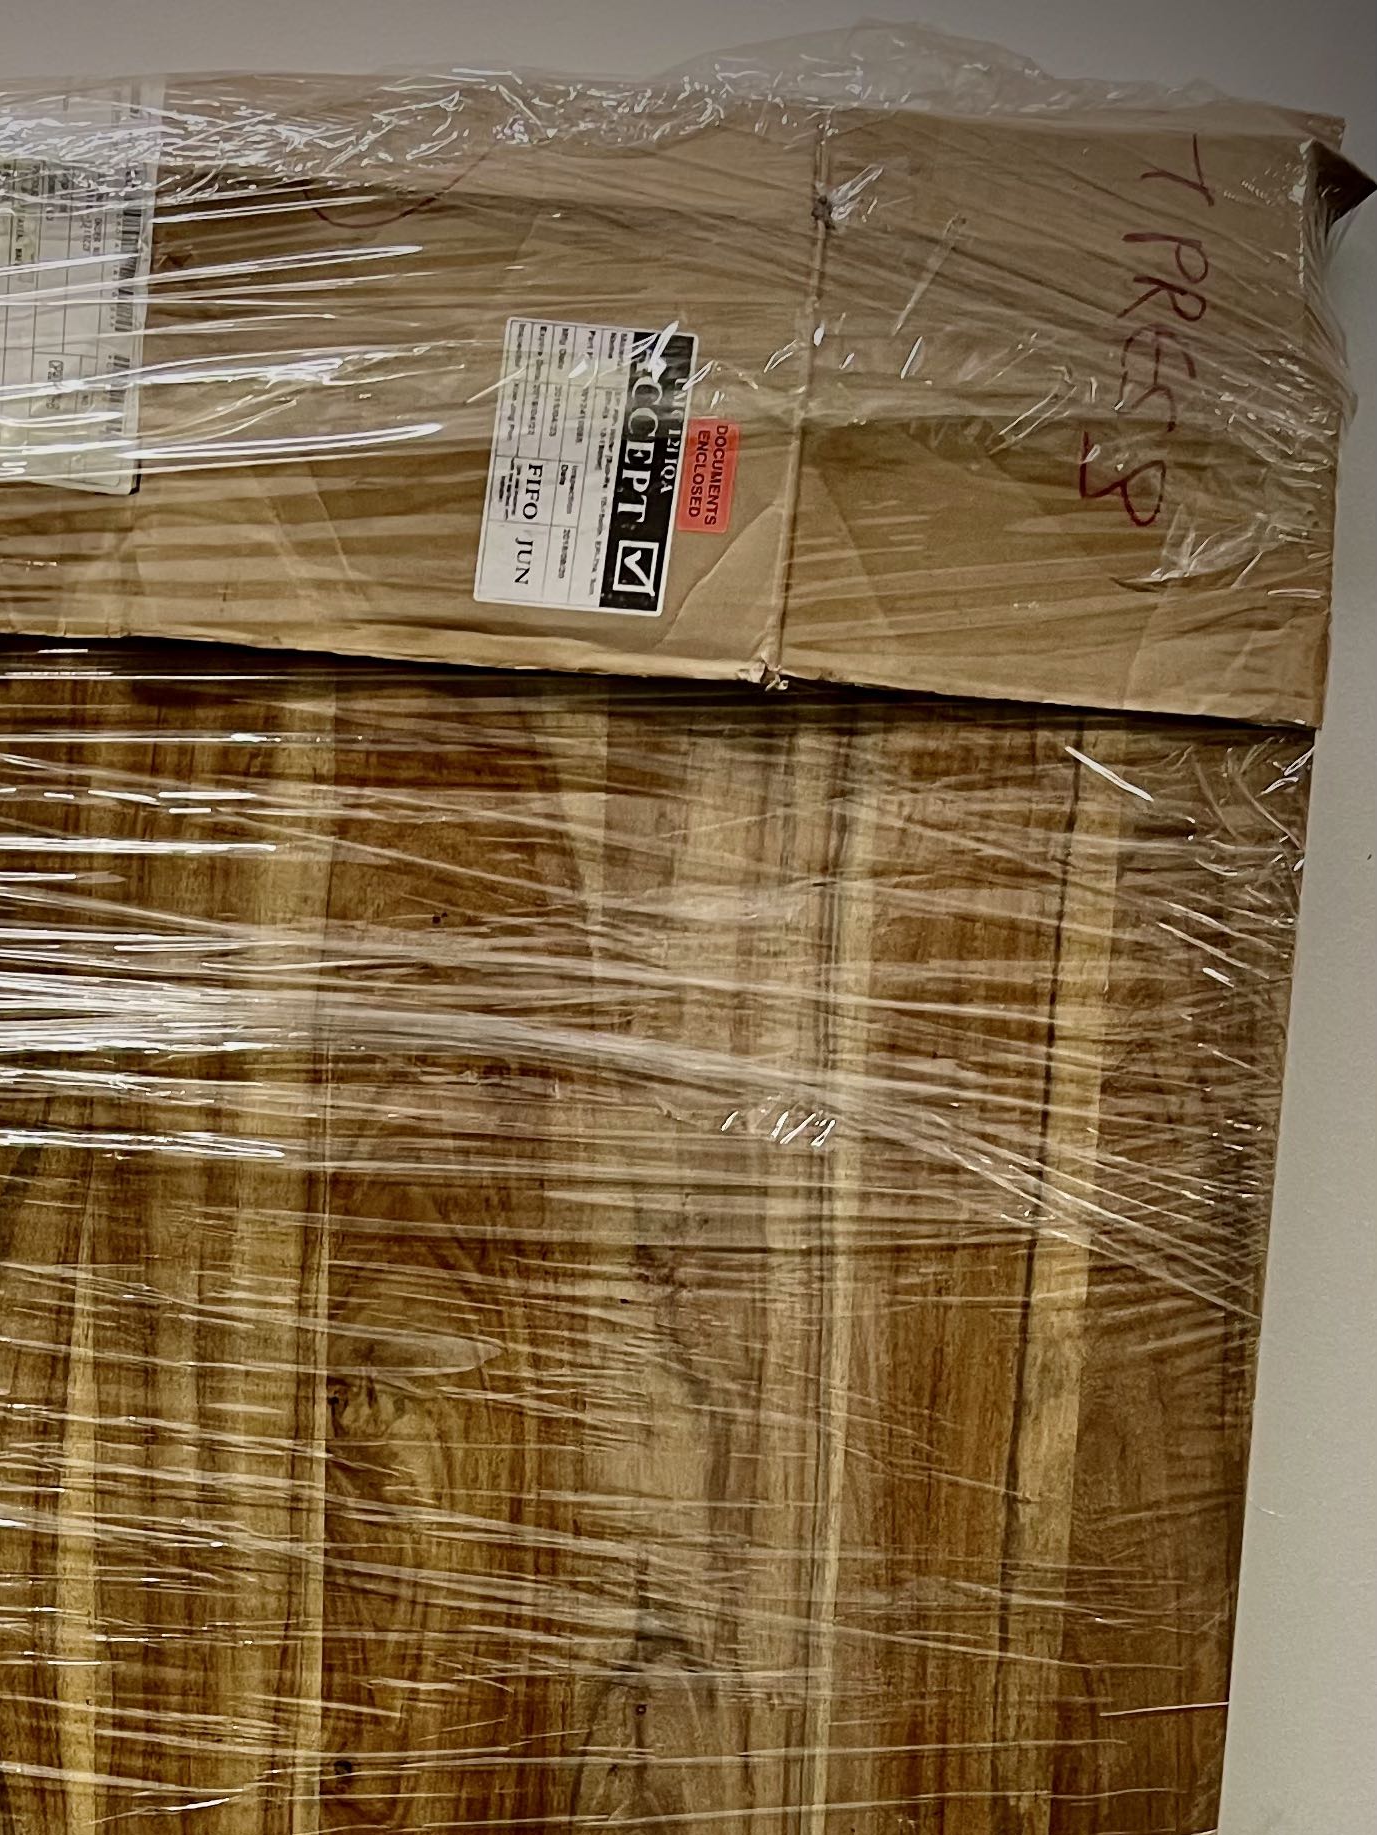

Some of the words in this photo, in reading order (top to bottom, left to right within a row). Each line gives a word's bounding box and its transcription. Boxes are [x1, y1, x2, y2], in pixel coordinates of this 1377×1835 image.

[523, 463, 543, 520] FIFO
[660, 457, 678, 494] IQA
[689, 430, 710, 518] ENCLOSED
[704, 425, 728, 526] DOCUMENTS
[514, 536, 533, 585] JUN
